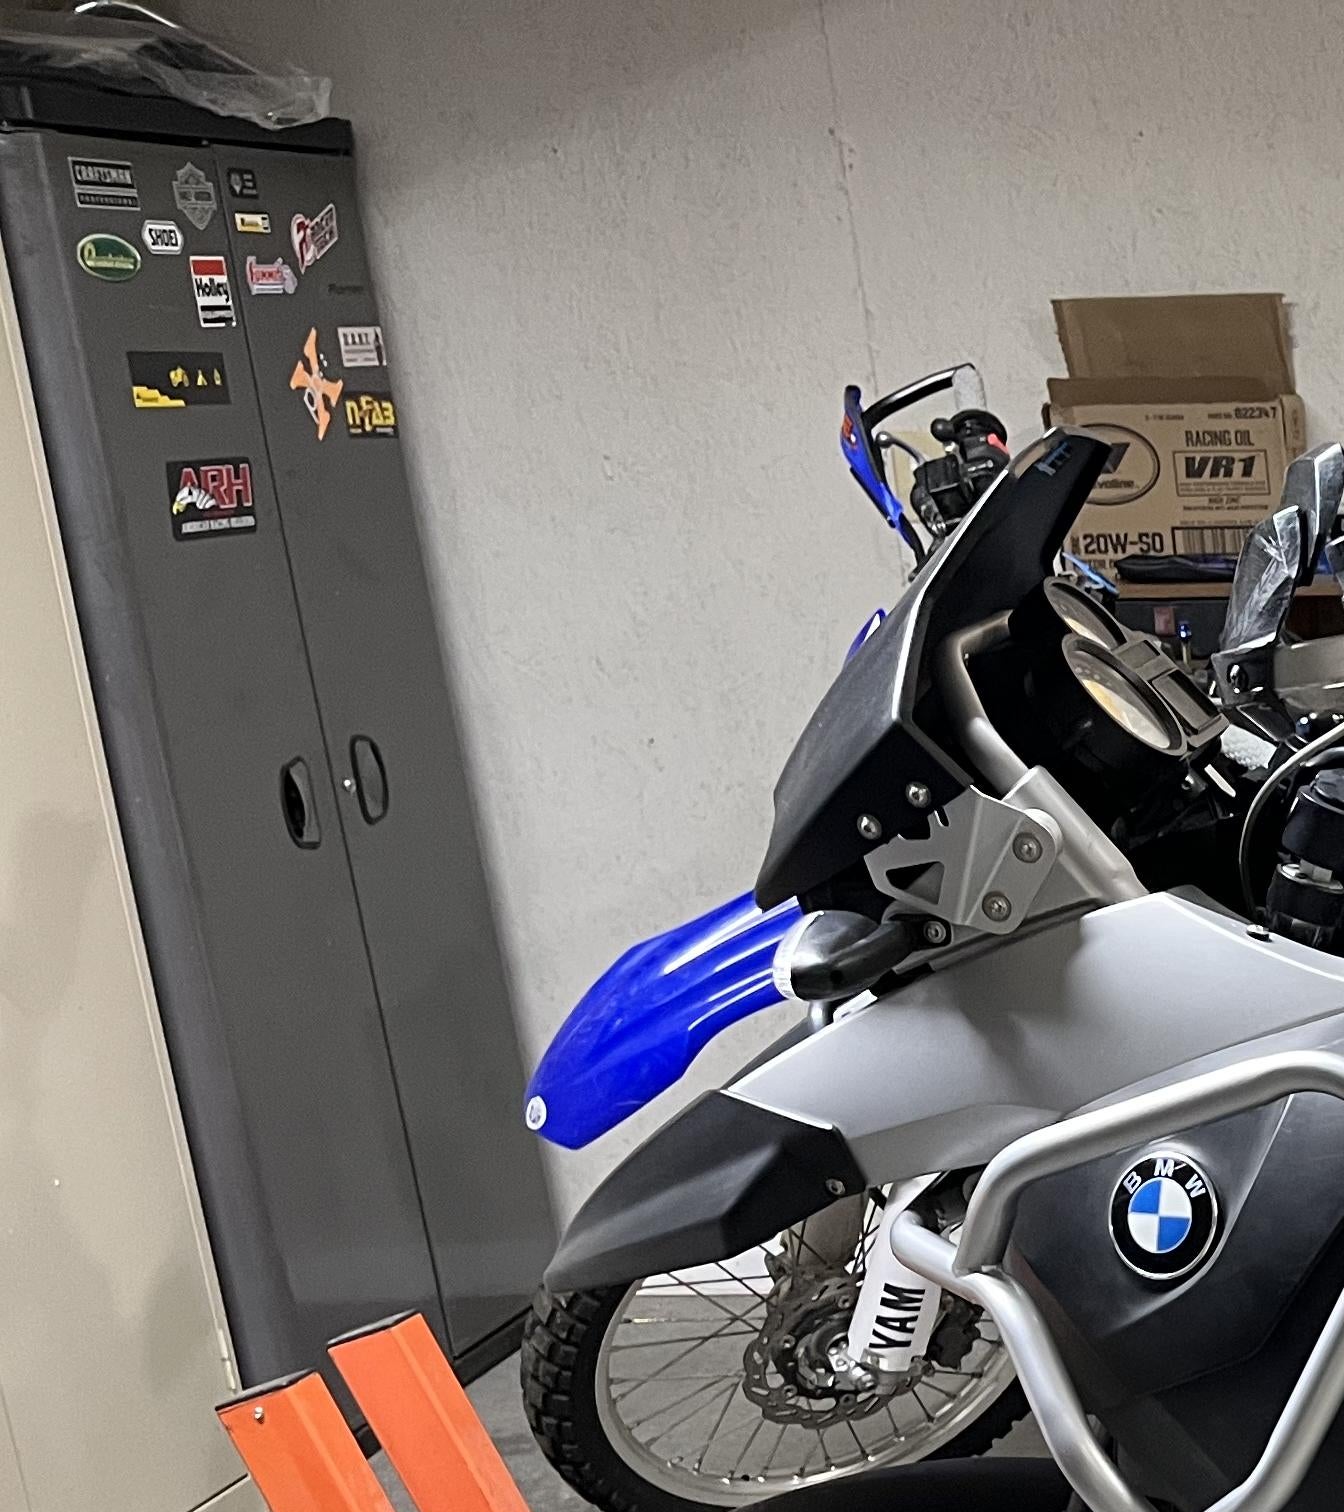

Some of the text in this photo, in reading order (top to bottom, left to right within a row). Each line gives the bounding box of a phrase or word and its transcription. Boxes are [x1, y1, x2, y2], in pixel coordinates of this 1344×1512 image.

[195, 278, 229, 303] Holley
[1185, 430, 1255, 447] RACING OIL
[1184, 455, 1256, 479] VR1
[1082, 532, 1165, 555] 20W-50
[1124, 1157, 1206, 1198] BMW
[868, 1282, 926, 1350] YAM
